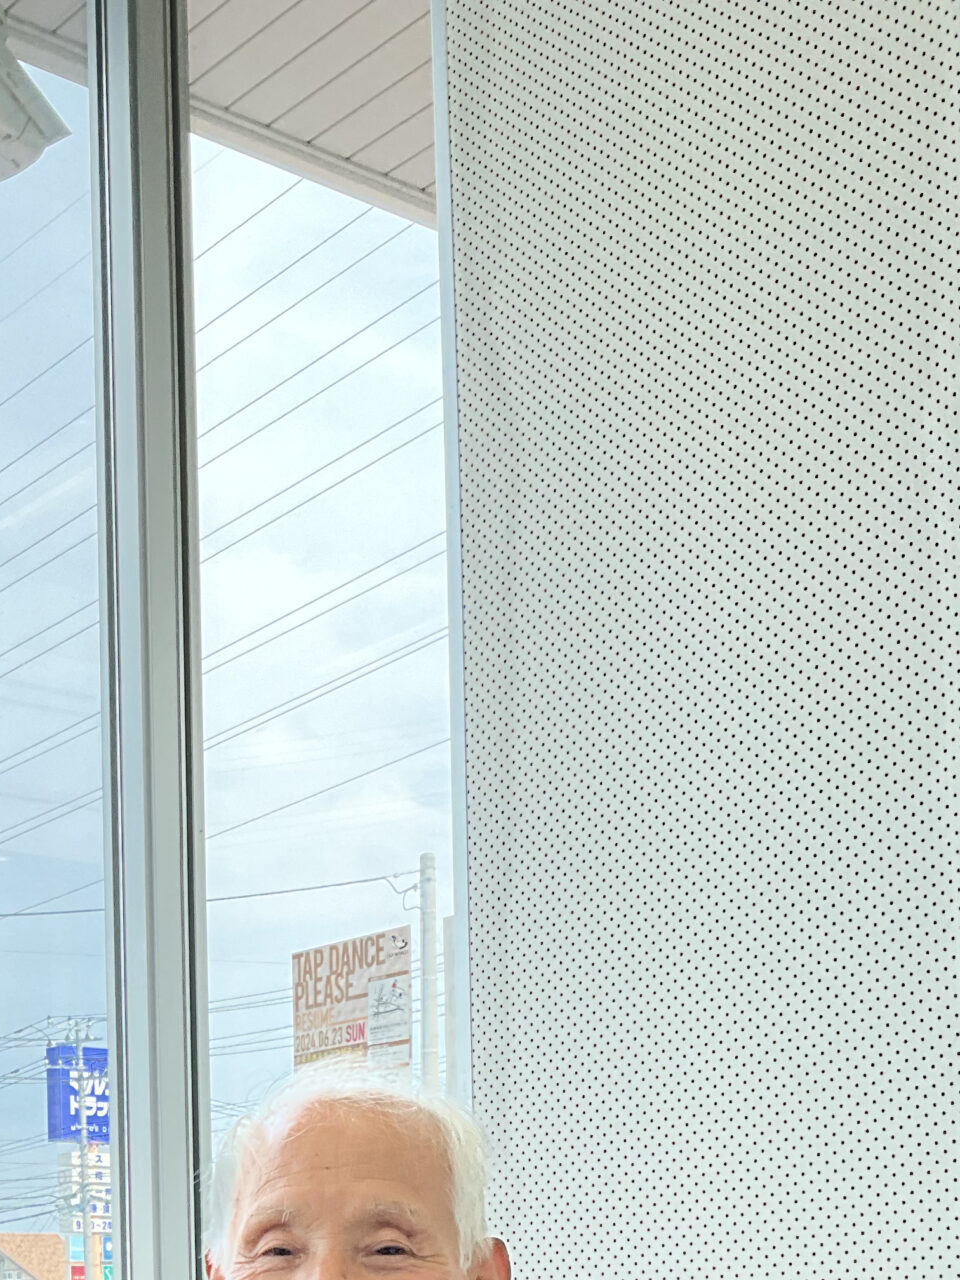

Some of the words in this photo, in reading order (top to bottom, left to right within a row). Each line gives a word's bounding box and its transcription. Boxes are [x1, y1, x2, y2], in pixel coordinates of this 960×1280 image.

[292, 948, 324, 985] TAP
[329, 933, 386, 977] DANCE
[295, 972, 354, 1012] PLEASE
[345, 1022, 366, 1043] SUN
